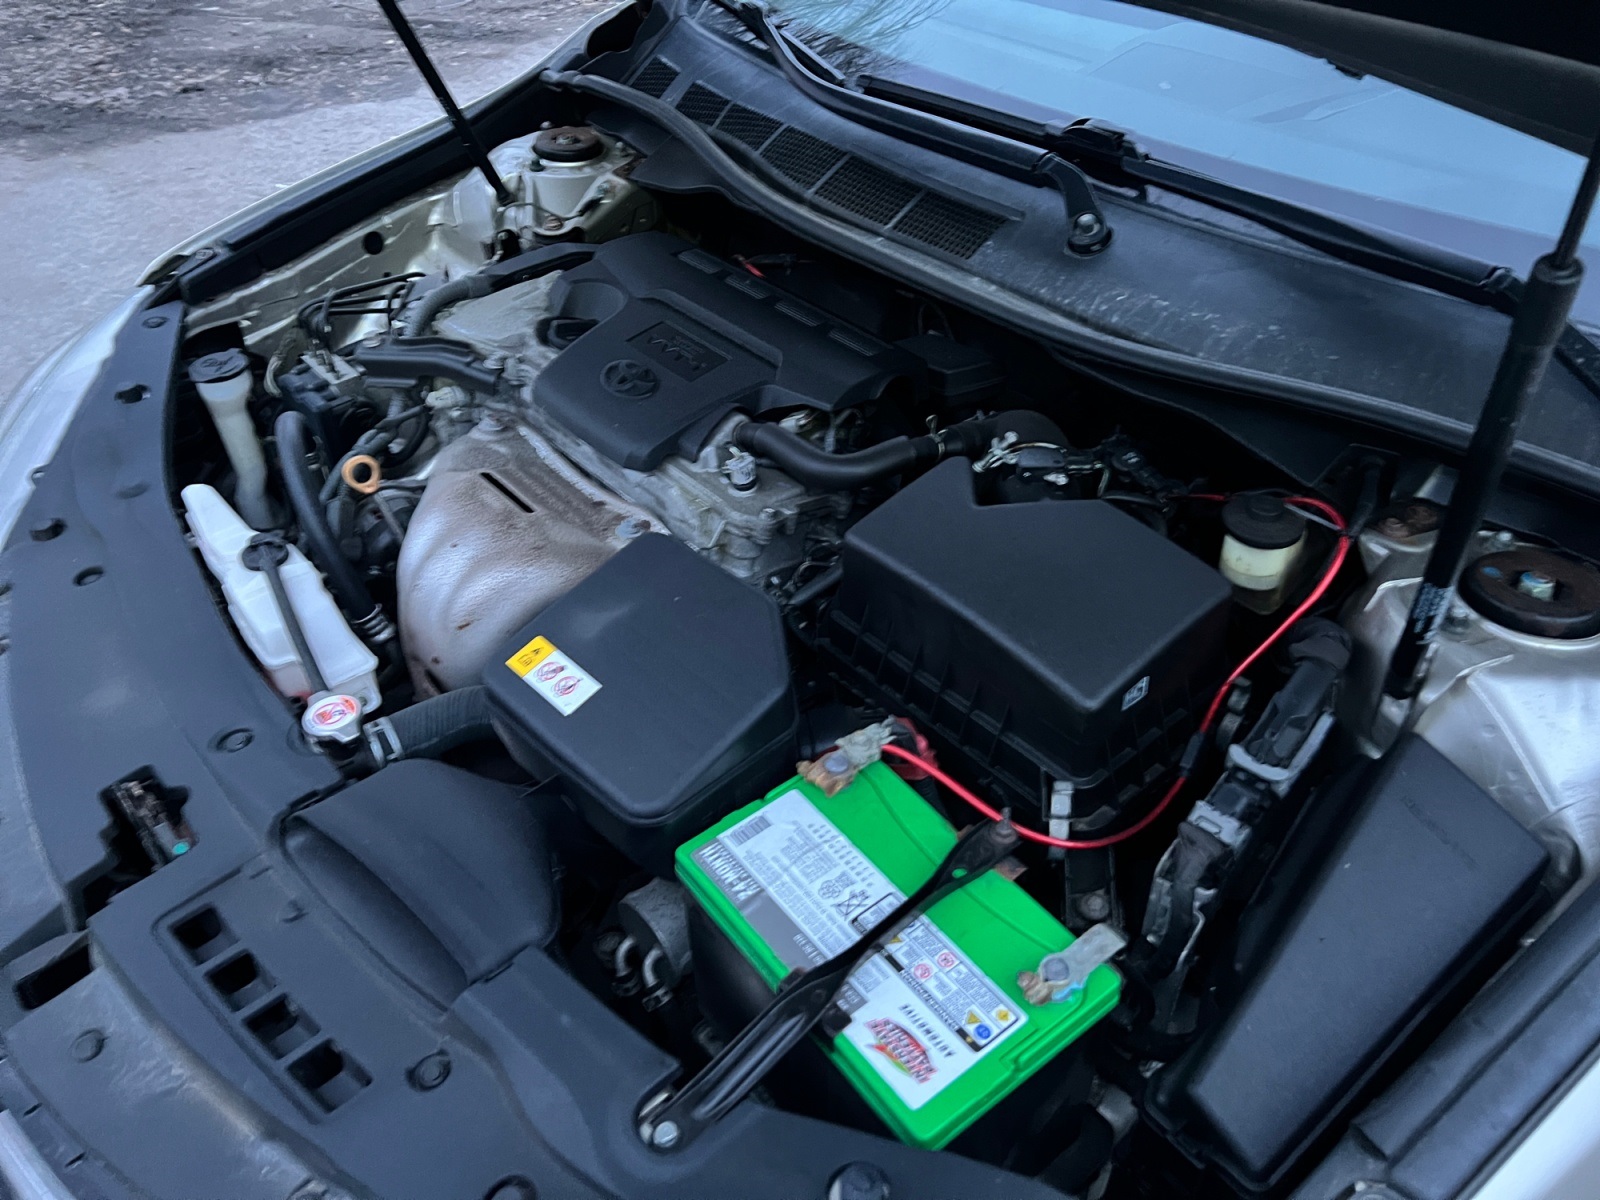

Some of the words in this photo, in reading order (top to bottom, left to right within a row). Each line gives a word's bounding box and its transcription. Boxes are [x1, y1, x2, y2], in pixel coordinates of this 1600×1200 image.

[867, 1018, 930, 1085] INTERSTATE
[877, 1016, 938, 1077] BATTERIES
[897, 1001, 957, 1059] AUTOMOTIVE
